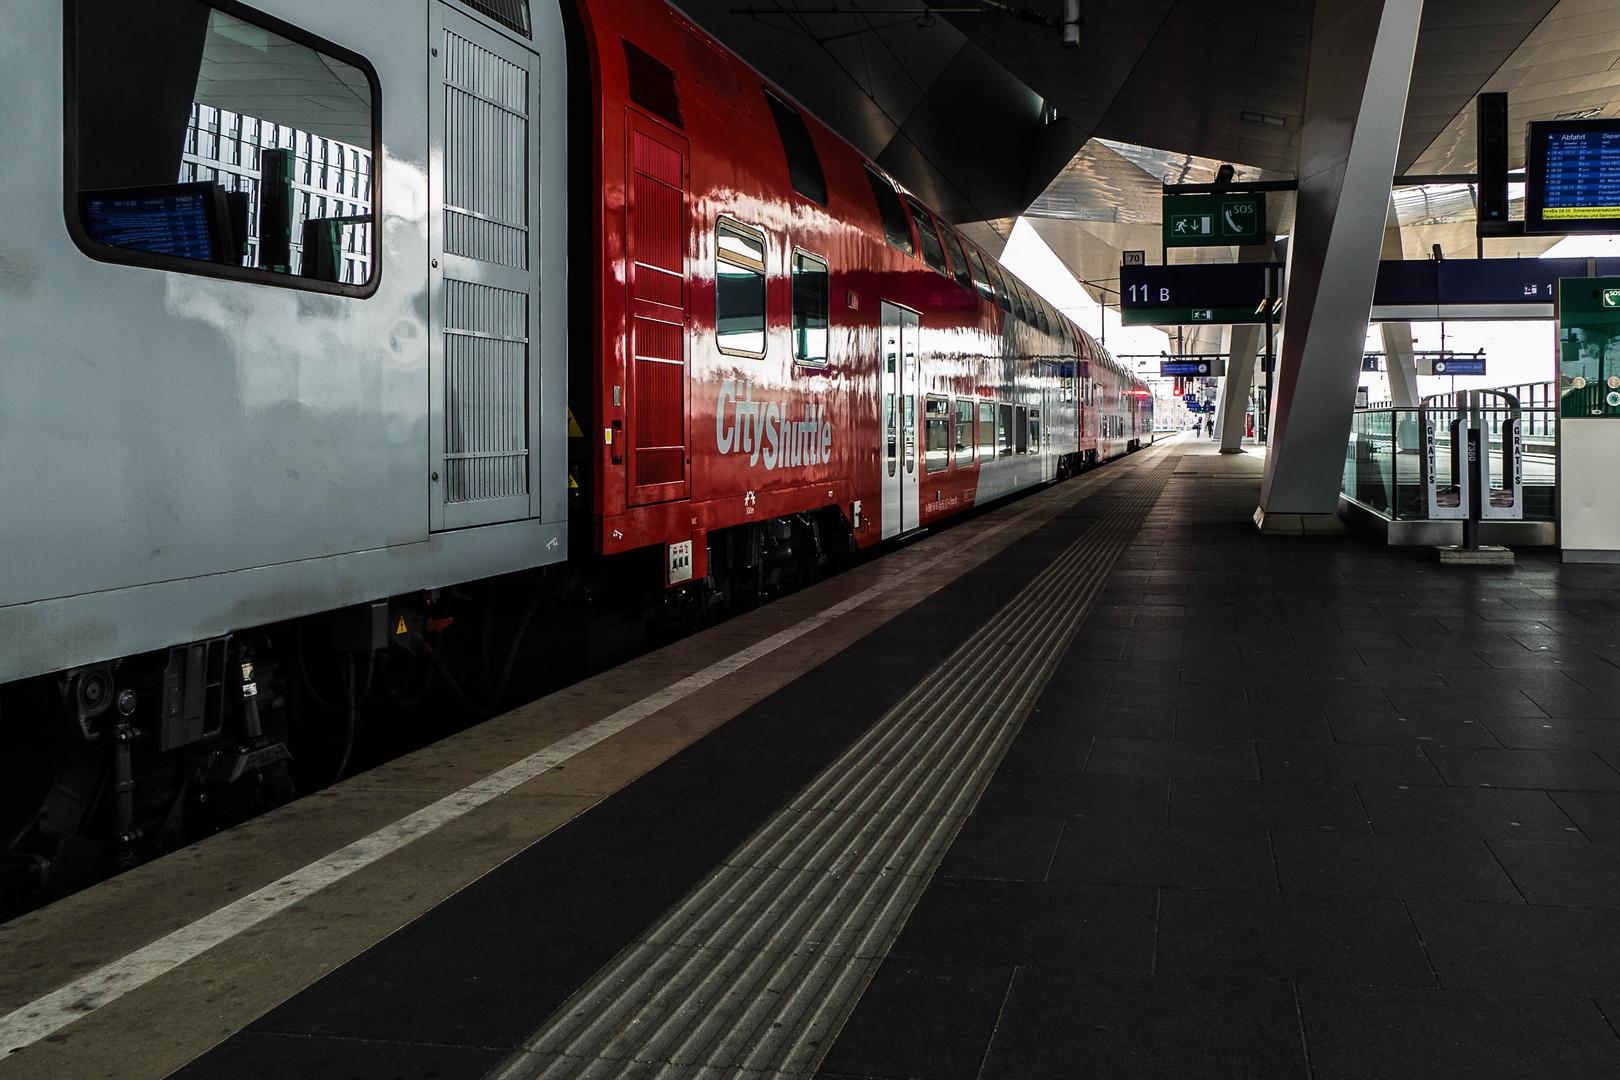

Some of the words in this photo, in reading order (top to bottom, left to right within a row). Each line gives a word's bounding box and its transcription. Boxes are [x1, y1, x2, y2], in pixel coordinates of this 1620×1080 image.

[1233, 204, 1253, 214] SOS
[1129, 254, 1140, 262] 70
[1129, 284, 1148, 302] 11
[1159, 288, 1170, 302] B
[716, 379, 832, 471] CityShuttle
[1427, 426, 1435, 484] GRATIS
[1468, 441, 1476, 462] 7380
[1513, 426, 1521, 485] GRATIS
